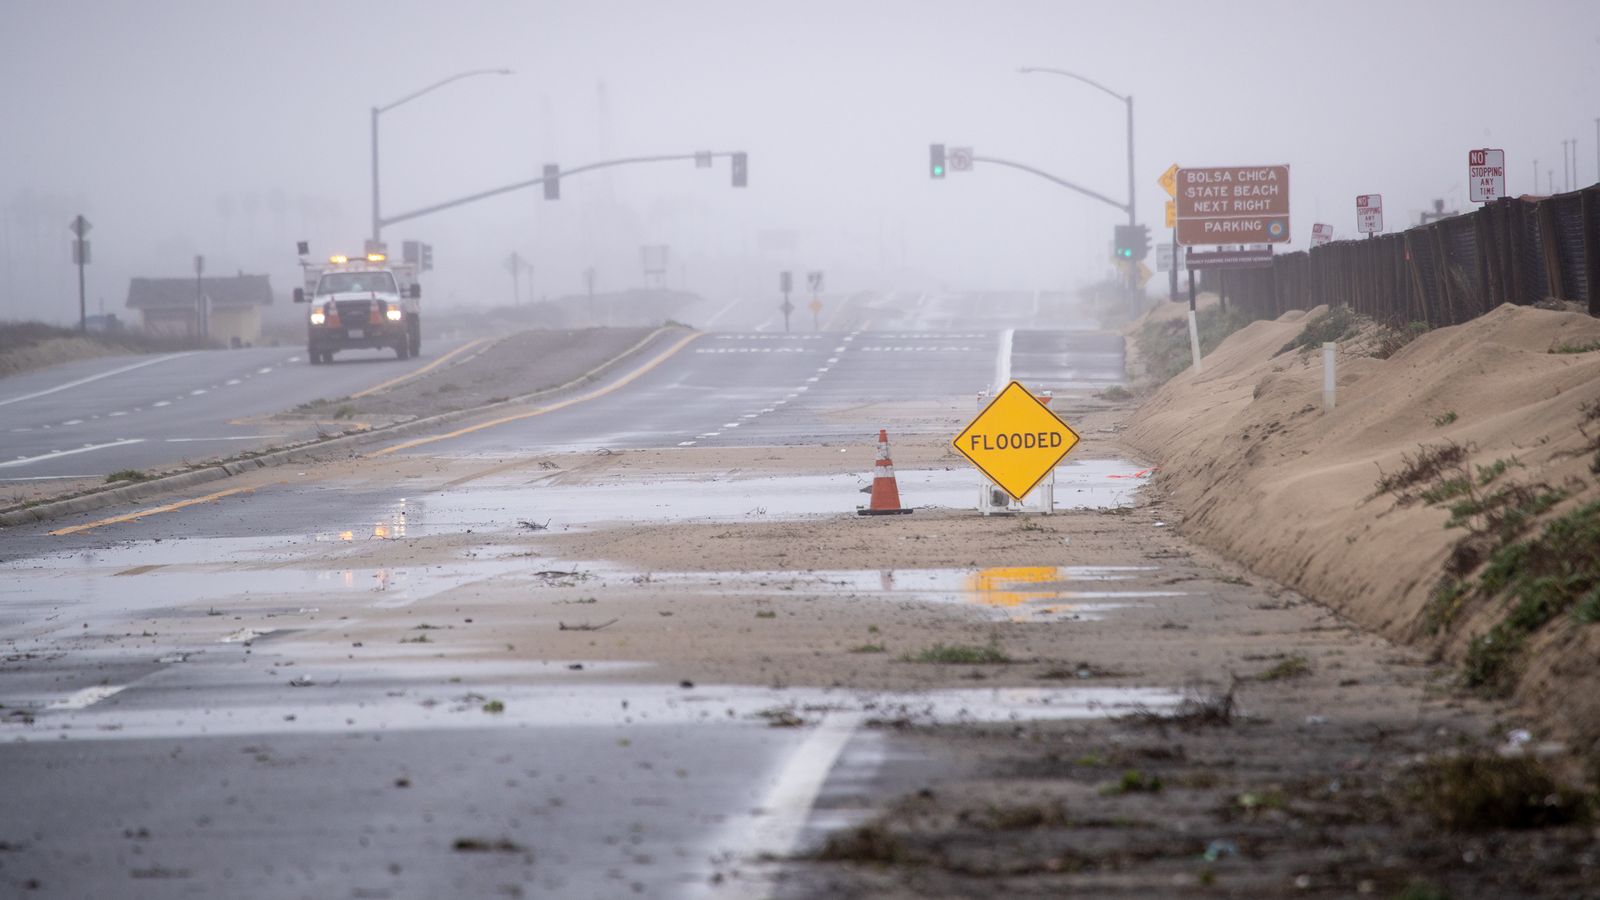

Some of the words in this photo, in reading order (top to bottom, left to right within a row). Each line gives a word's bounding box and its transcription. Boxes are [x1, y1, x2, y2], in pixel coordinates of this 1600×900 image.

[1471, 152, 1484, 164] NO
[1187, 172, 1232, 183] BOLSA
[1238, 170, 1277, 181] CHICA
[1472, 167, 1502, 177] STOPPING
[1481, 178, 1493, 186] ANY
[1187, 186, 1229, 198] STATE
[1234, 185, 1278, 196] BEACH
[1480, 187, 1495, 195] TIME
[1194, 201, 1228, 212] NEXT
[1234, 199, 1271, 211] RIGHT
[1357, 196, 1367, 206] NO
[1205, 220, 1262, 232] PARKING
[971, 432, 1062, 451] FLOODED
